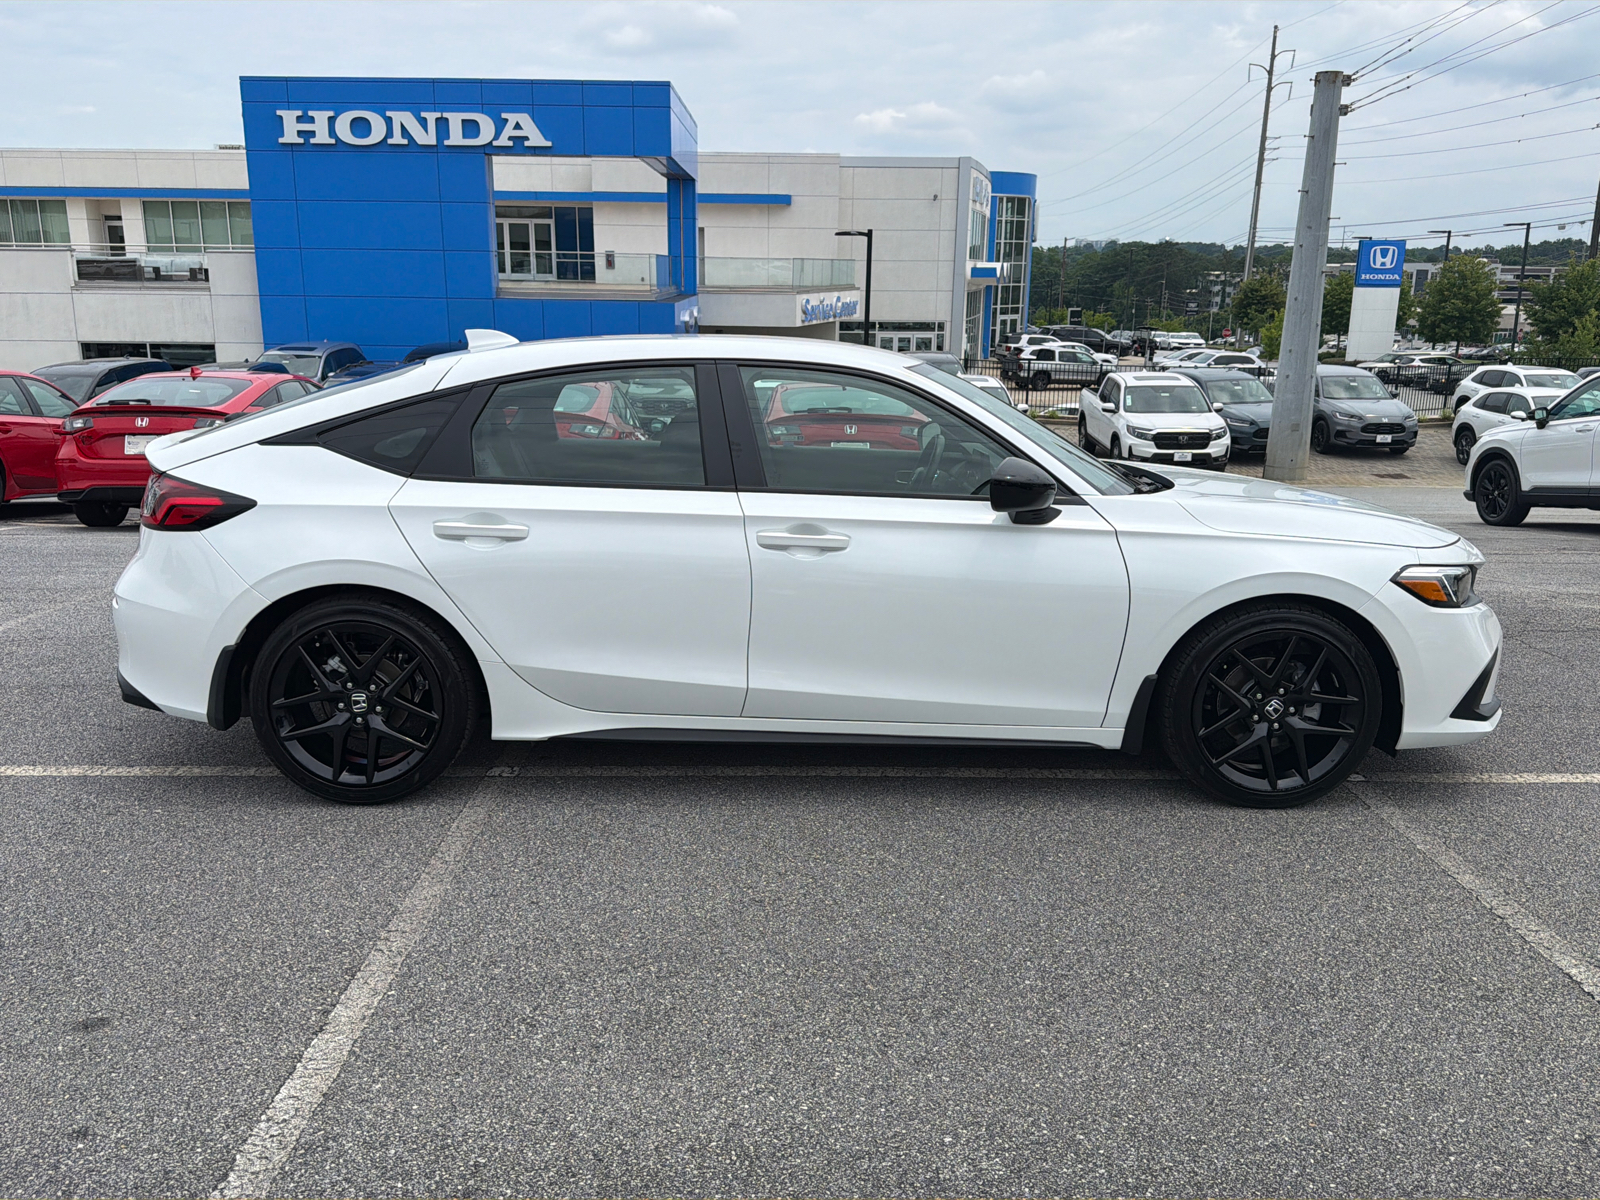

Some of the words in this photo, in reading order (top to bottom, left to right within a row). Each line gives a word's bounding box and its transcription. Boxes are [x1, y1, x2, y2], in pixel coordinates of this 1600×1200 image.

[276, 110, 552, 146] HONDA
[802, 297, 833, 322] Service
[834, 295, 858, 318] Center
